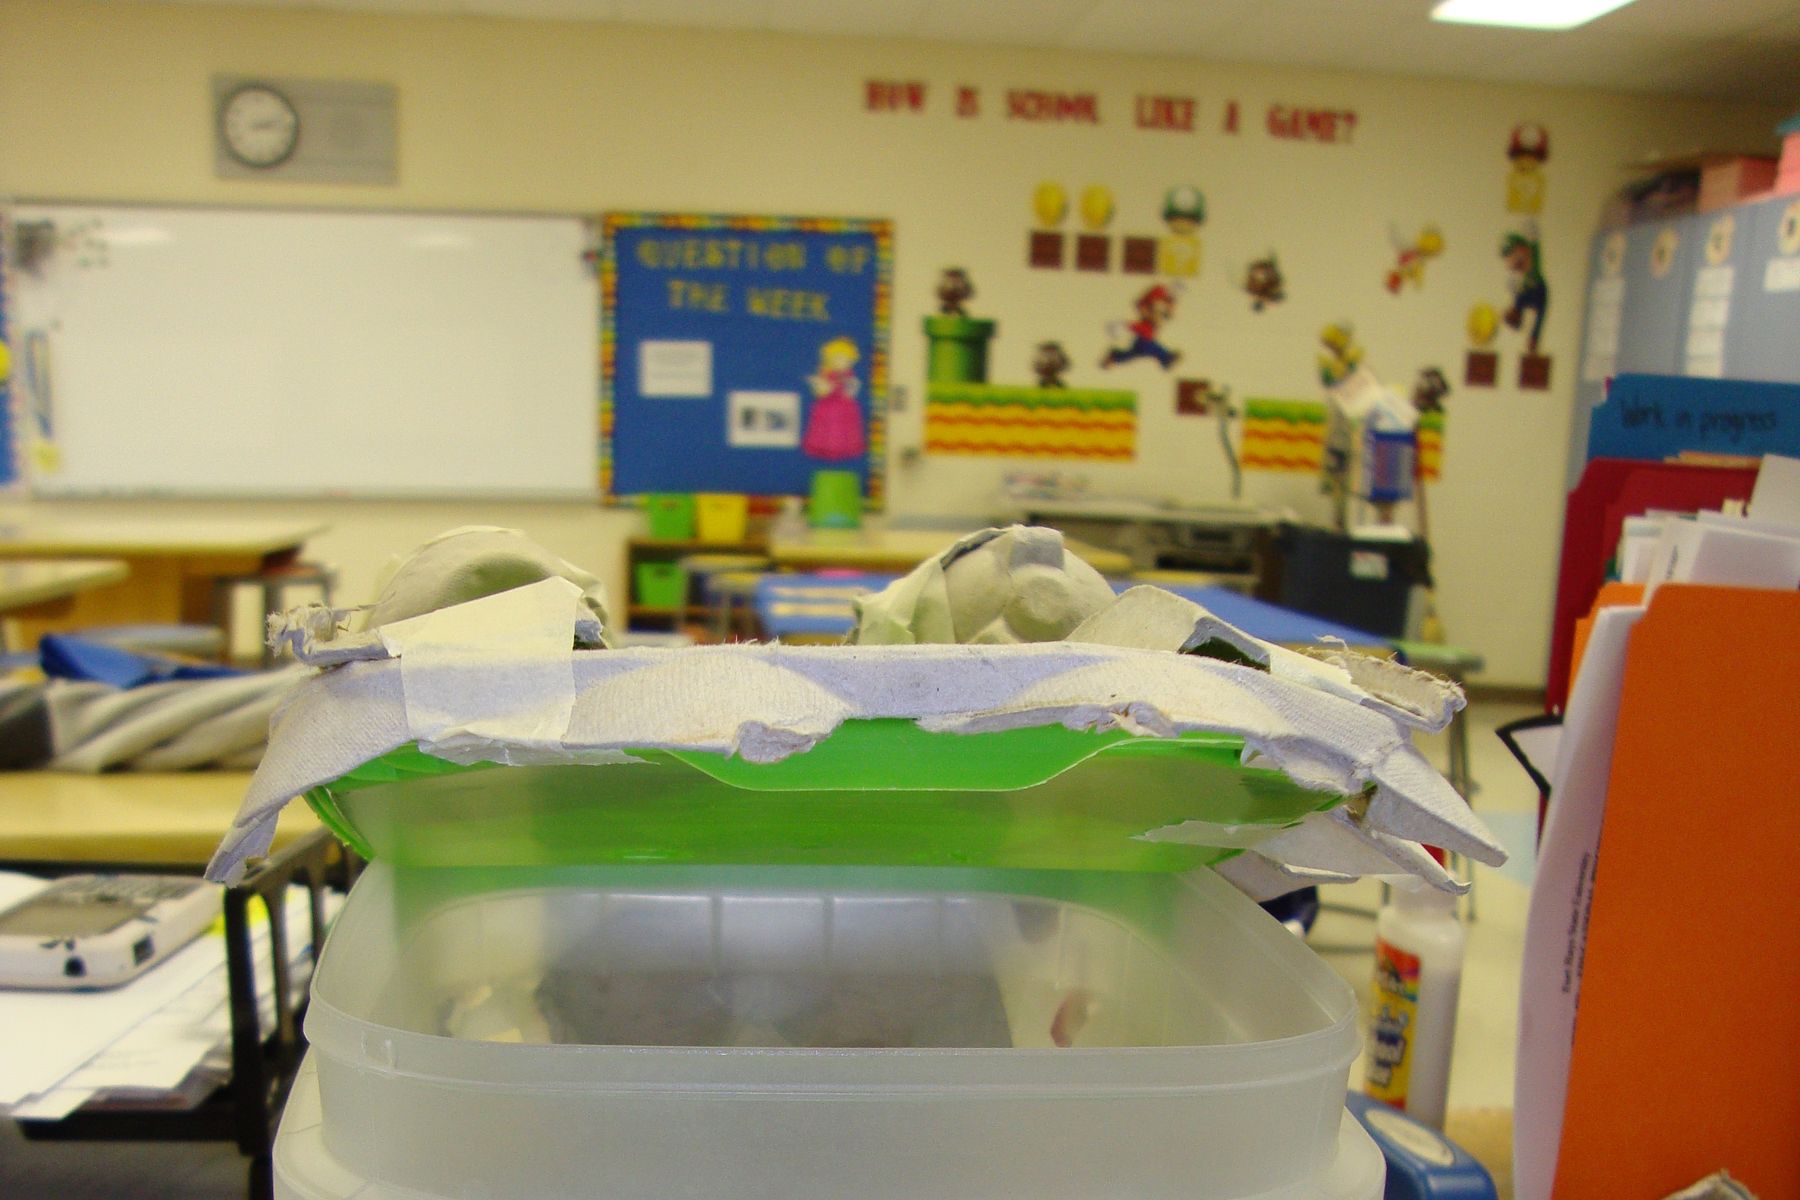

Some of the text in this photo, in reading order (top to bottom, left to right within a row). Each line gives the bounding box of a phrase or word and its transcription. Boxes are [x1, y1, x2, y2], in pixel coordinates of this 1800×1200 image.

[637, 239, 868, 273] QUESTION OF
[668, 279, 829, 321] THE WEEK
